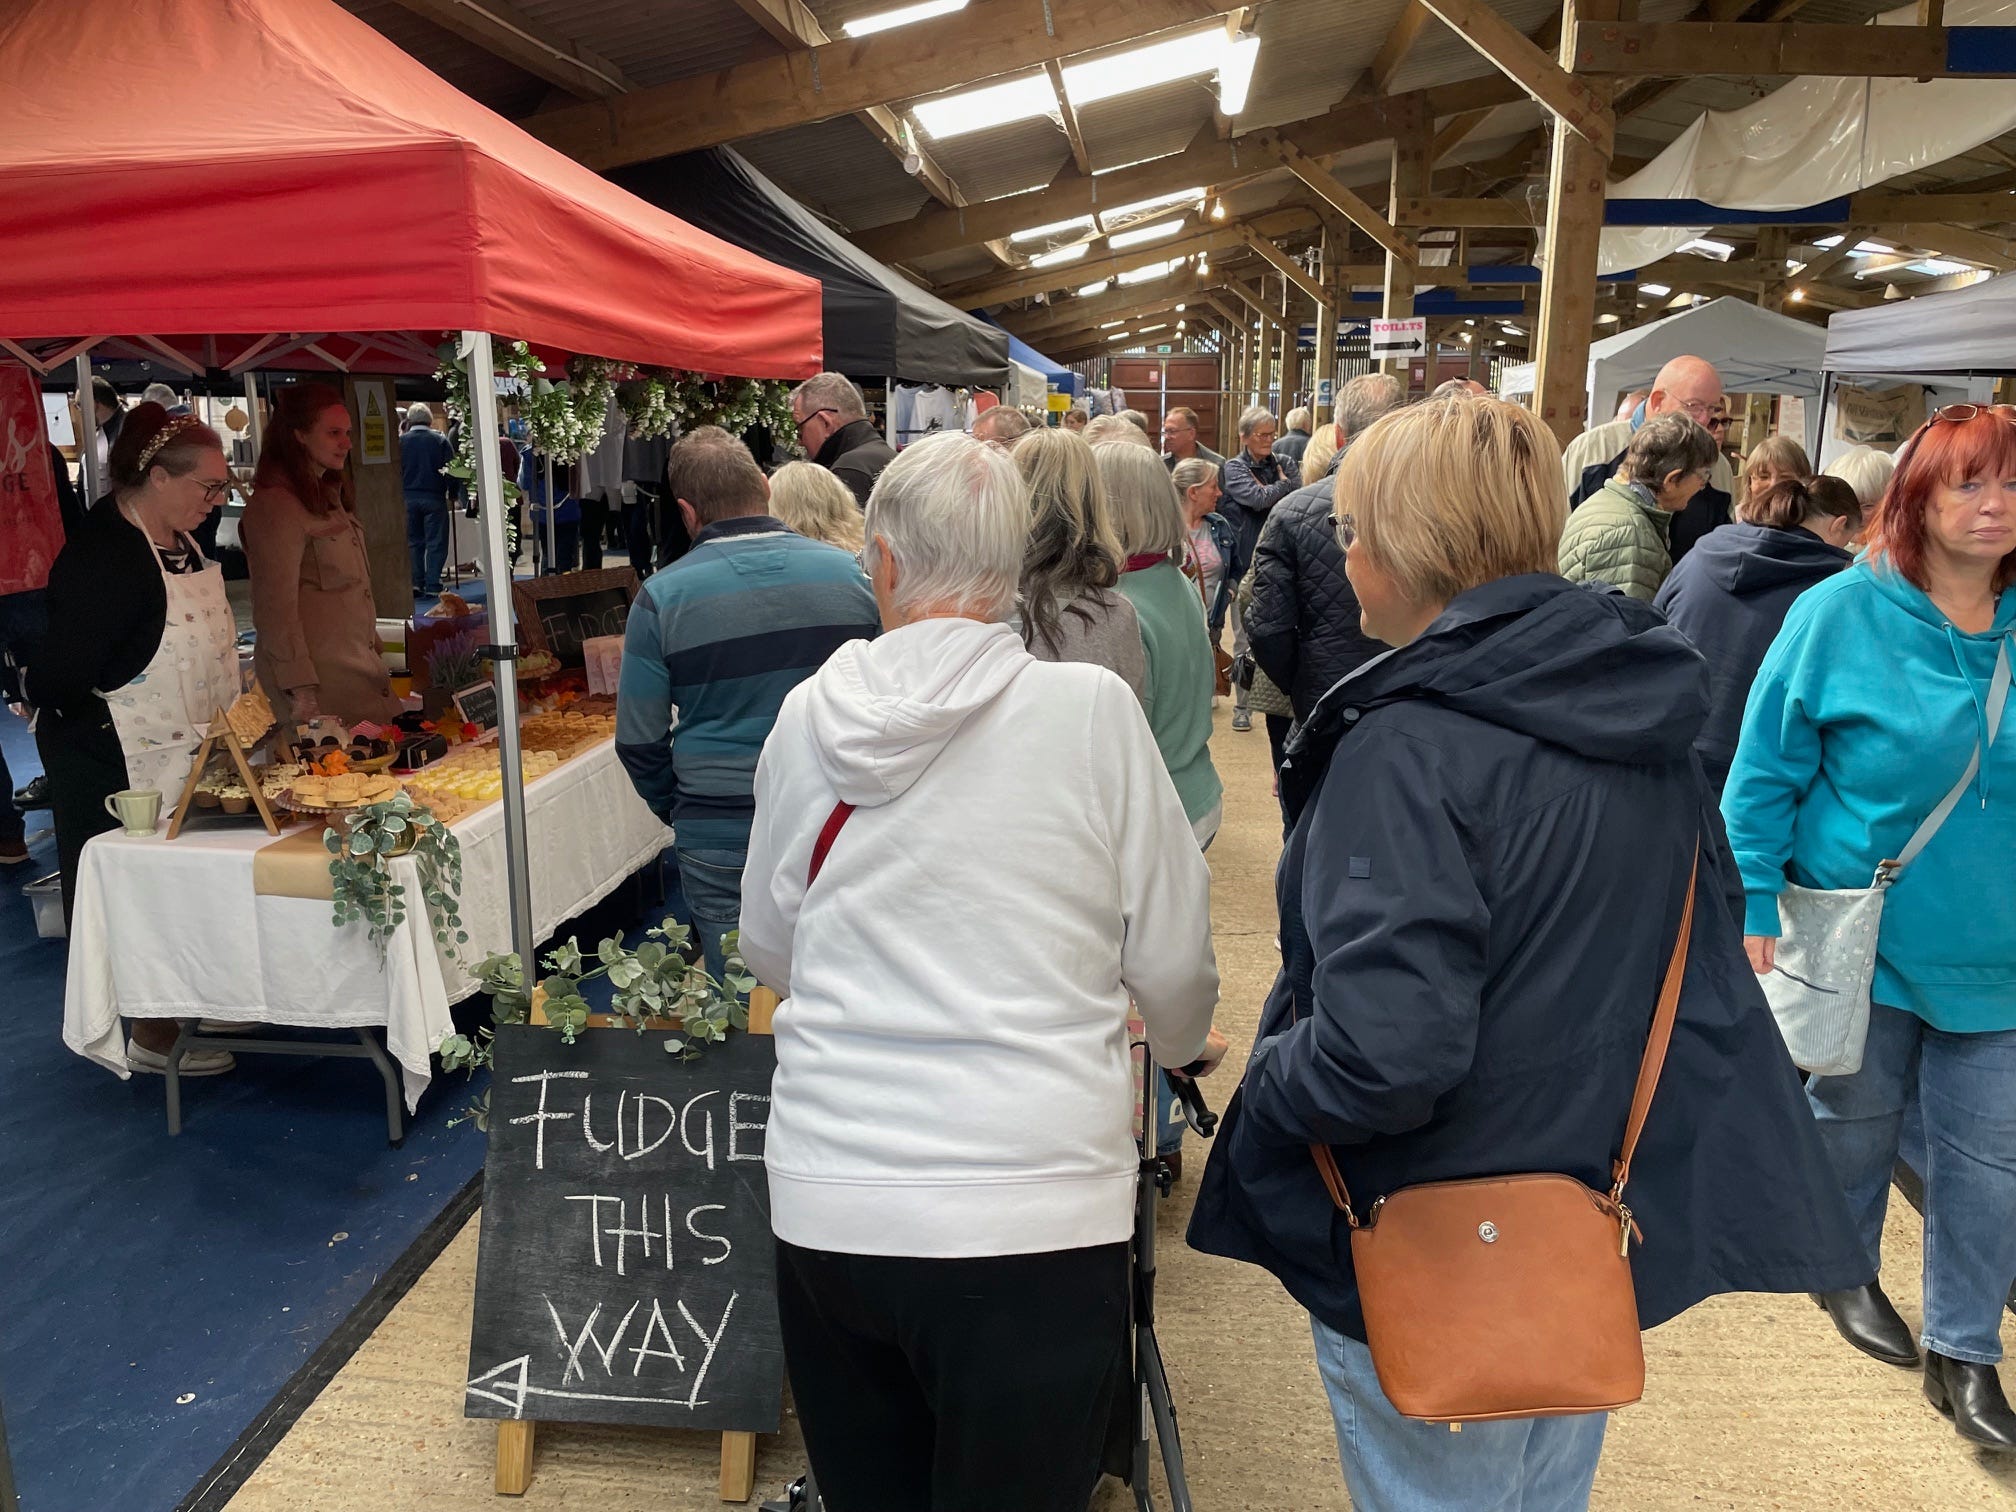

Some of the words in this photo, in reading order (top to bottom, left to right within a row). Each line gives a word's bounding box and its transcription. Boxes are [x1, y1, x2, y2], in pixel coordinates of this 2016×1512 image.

[1374, 322, 1423, 332] TOILETS
[509, 1069, 771, 1171] FUDGE
[564, 1193, 732, 1276] THIS
[543, 1289, 740, 1411] WAY
